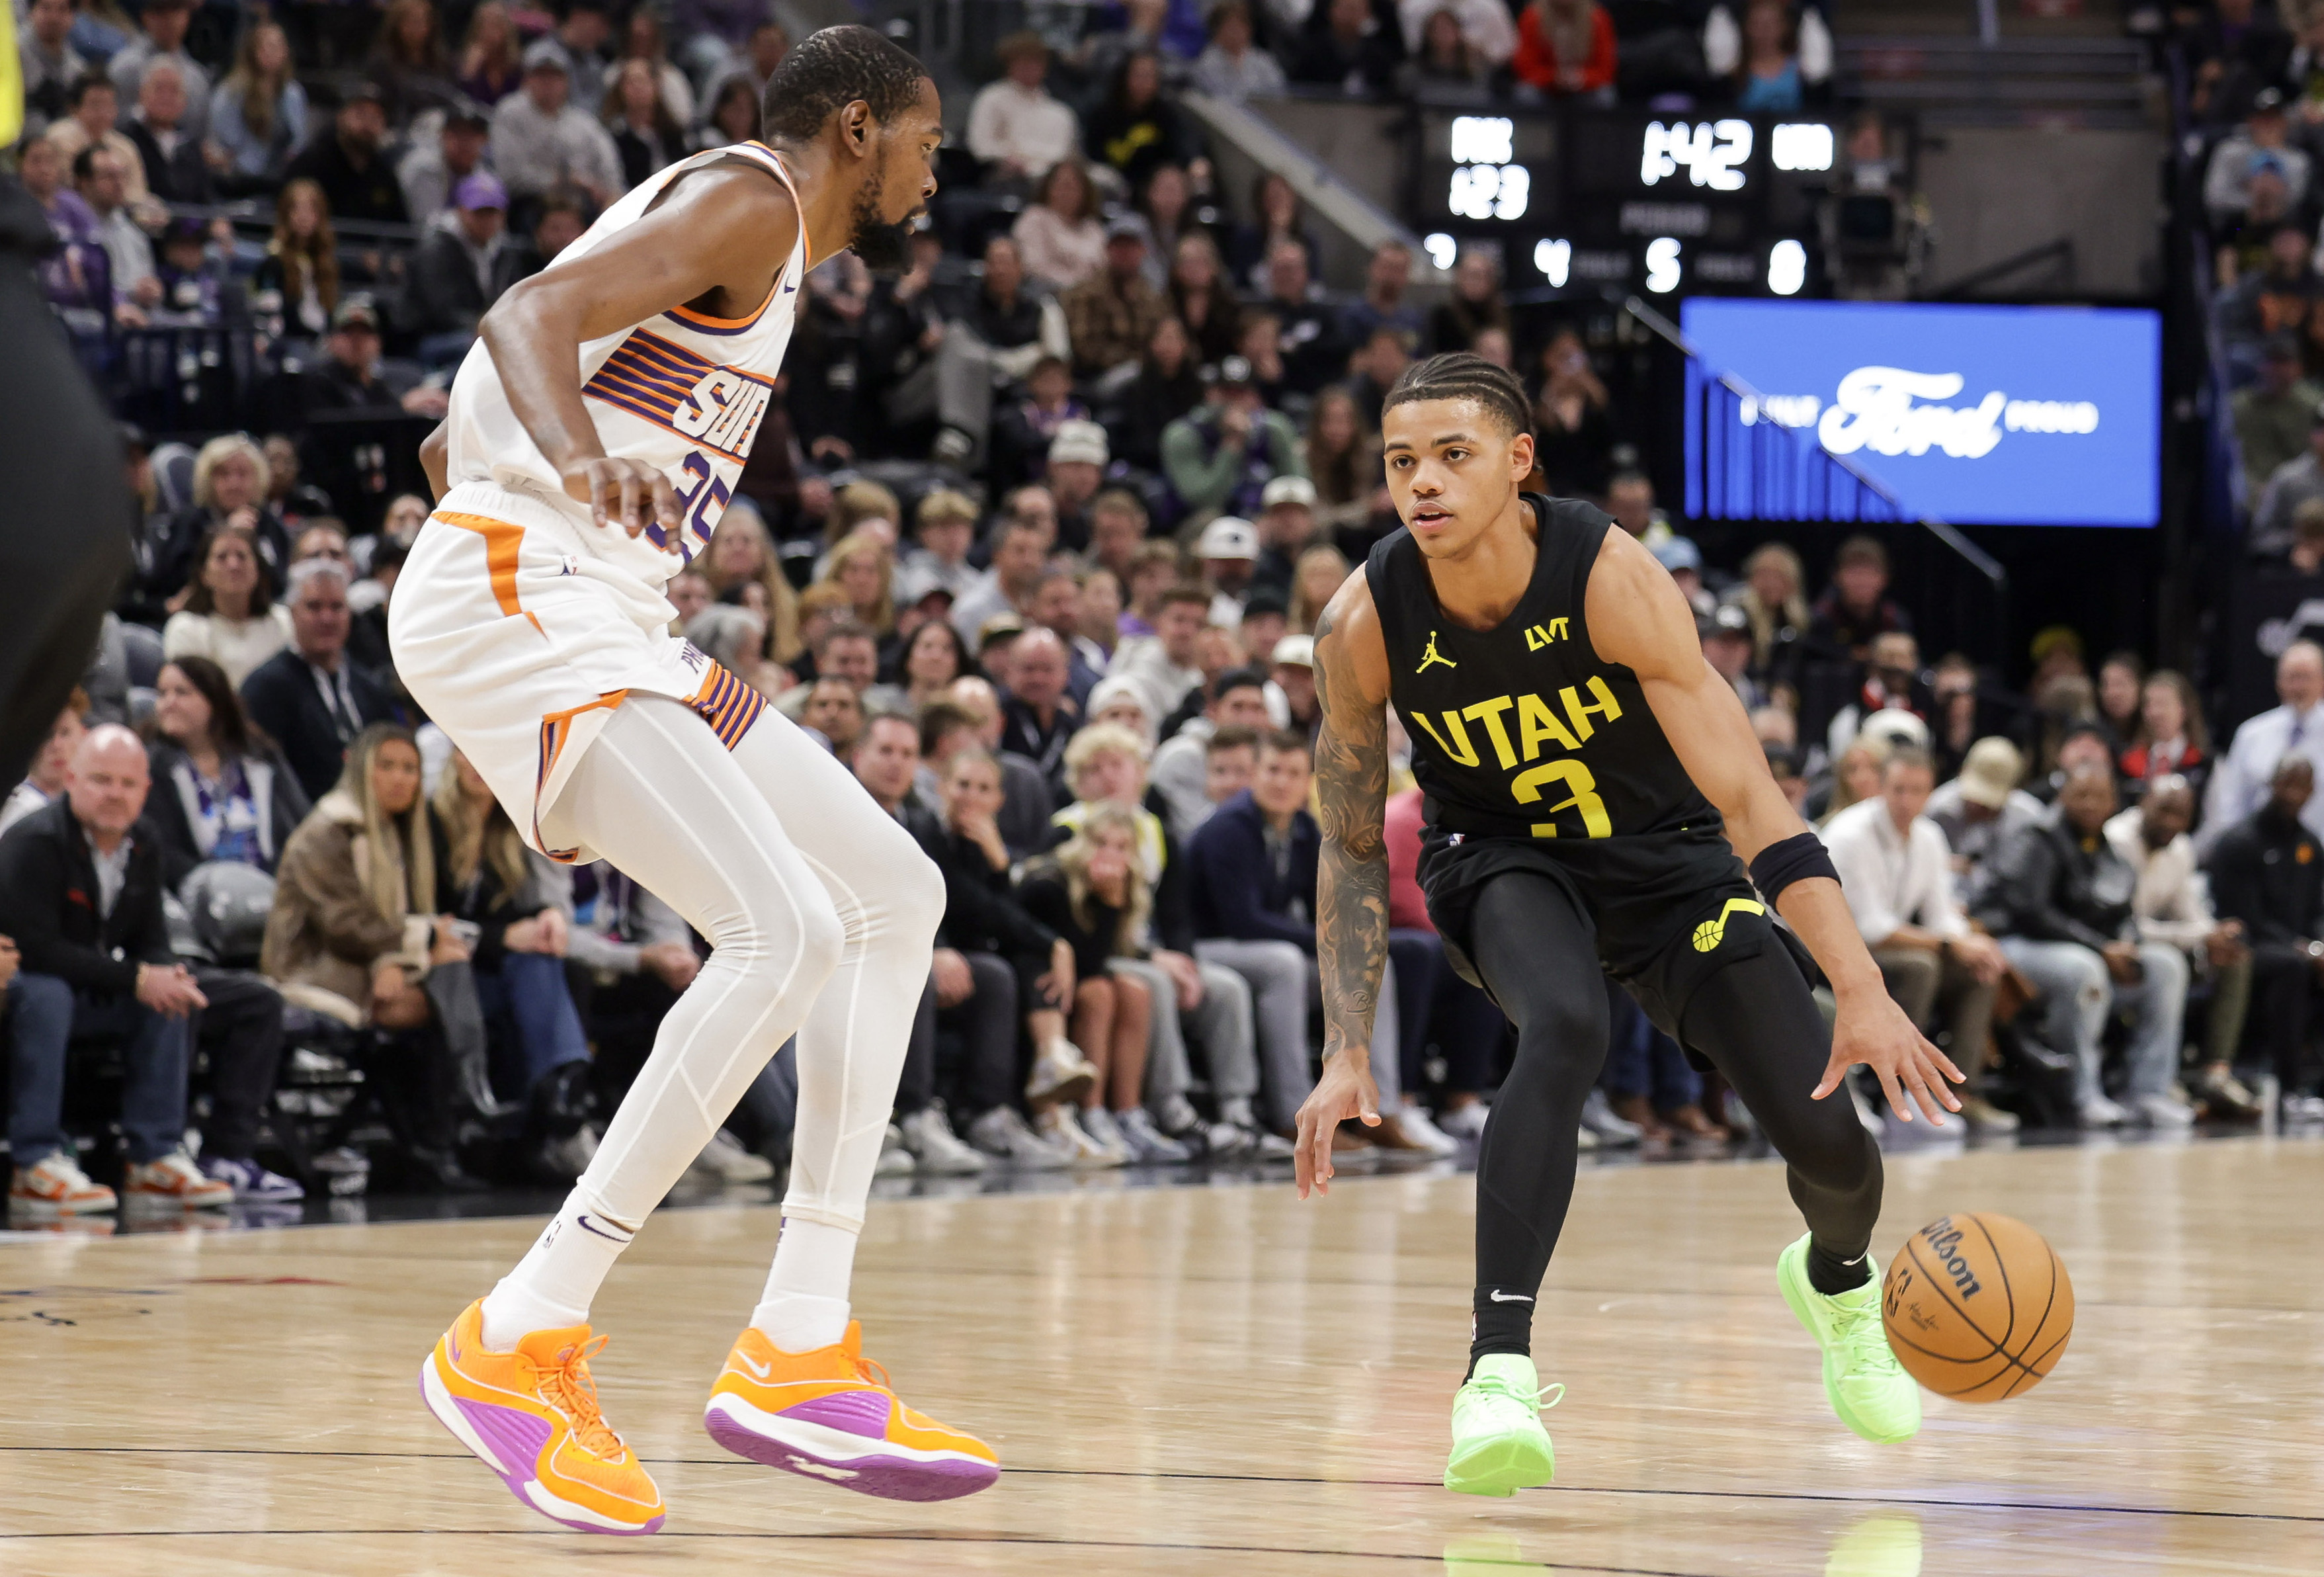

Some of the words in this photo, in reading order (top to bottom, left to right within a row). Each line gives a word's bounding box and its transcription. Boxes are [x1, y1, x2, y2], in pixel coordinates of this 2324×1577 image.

[1646, 237, 1681, 293] 5
[1819, 366, 2007, 459] Ford
[1524, 617, 1569, 652] LVT
[1410, 675, 1623, 771] UTAH
[1511, 759, 1612, 839] 3
